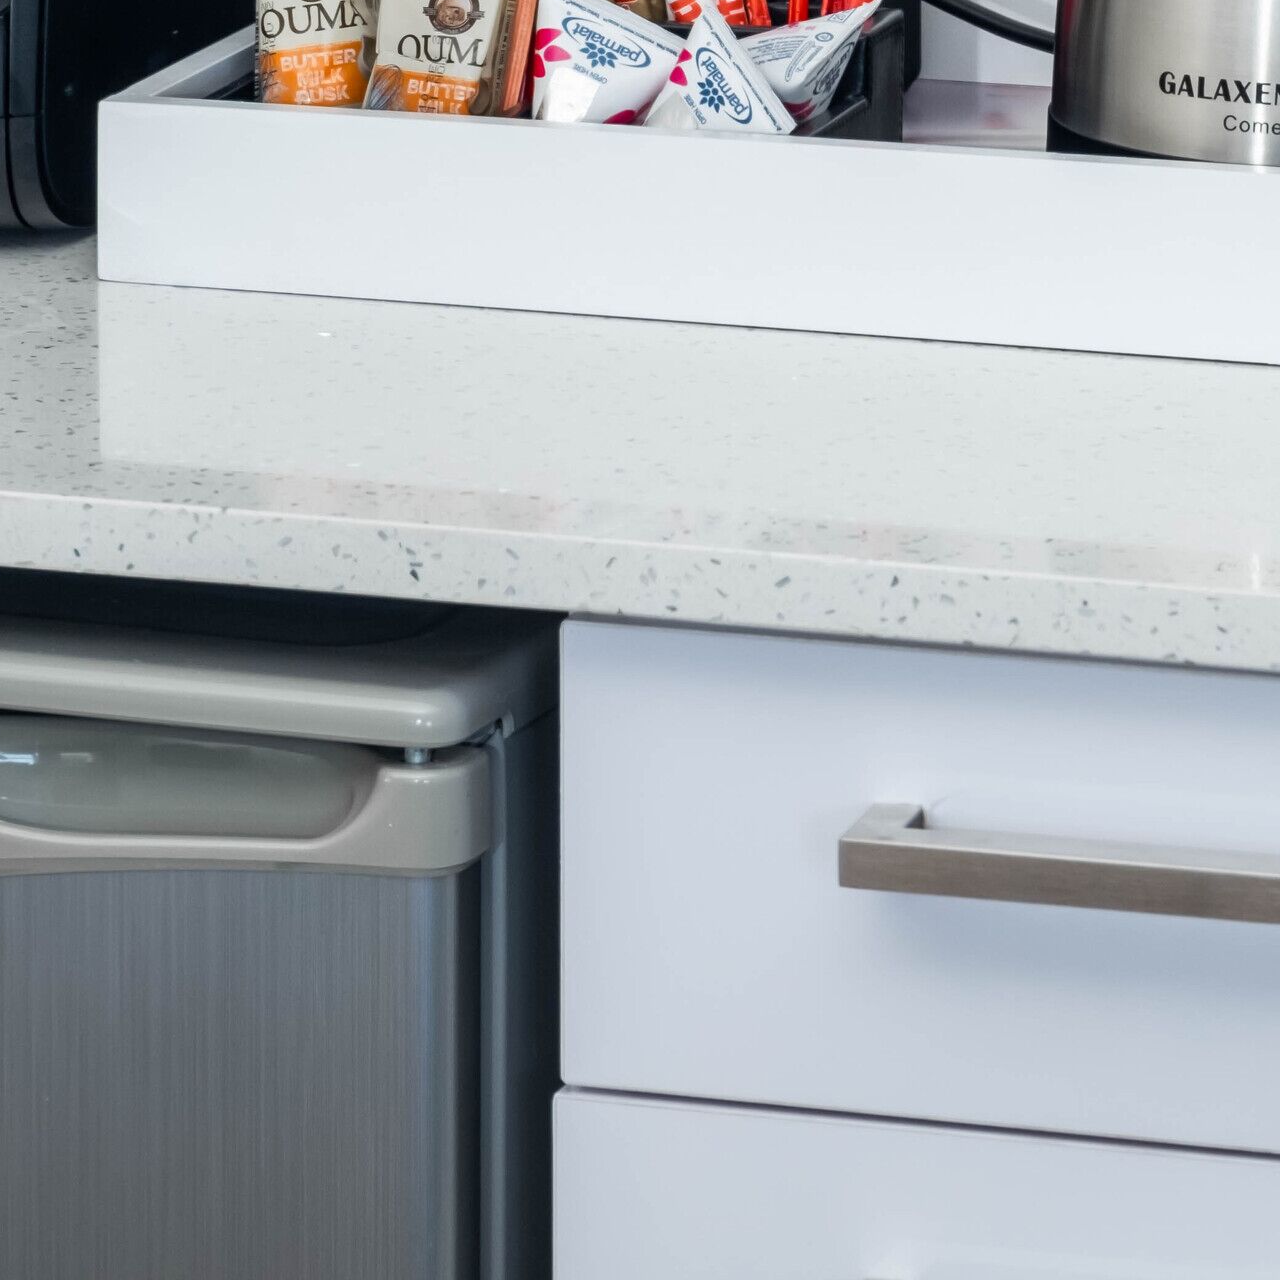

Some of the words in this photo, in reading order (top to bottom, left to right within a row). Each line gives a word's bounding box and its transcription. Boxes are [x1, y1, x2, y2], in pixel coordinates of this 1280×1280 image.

[261, 0, 368, 39] OUMA
[280, 48, 357, 72] BUTTER
[397, 34, 486, 68] OUM
[572, 23, 642, 62] parmalat
[297, 67, 345, 87] MILK
[701, 56, 749, 116] parmalat
